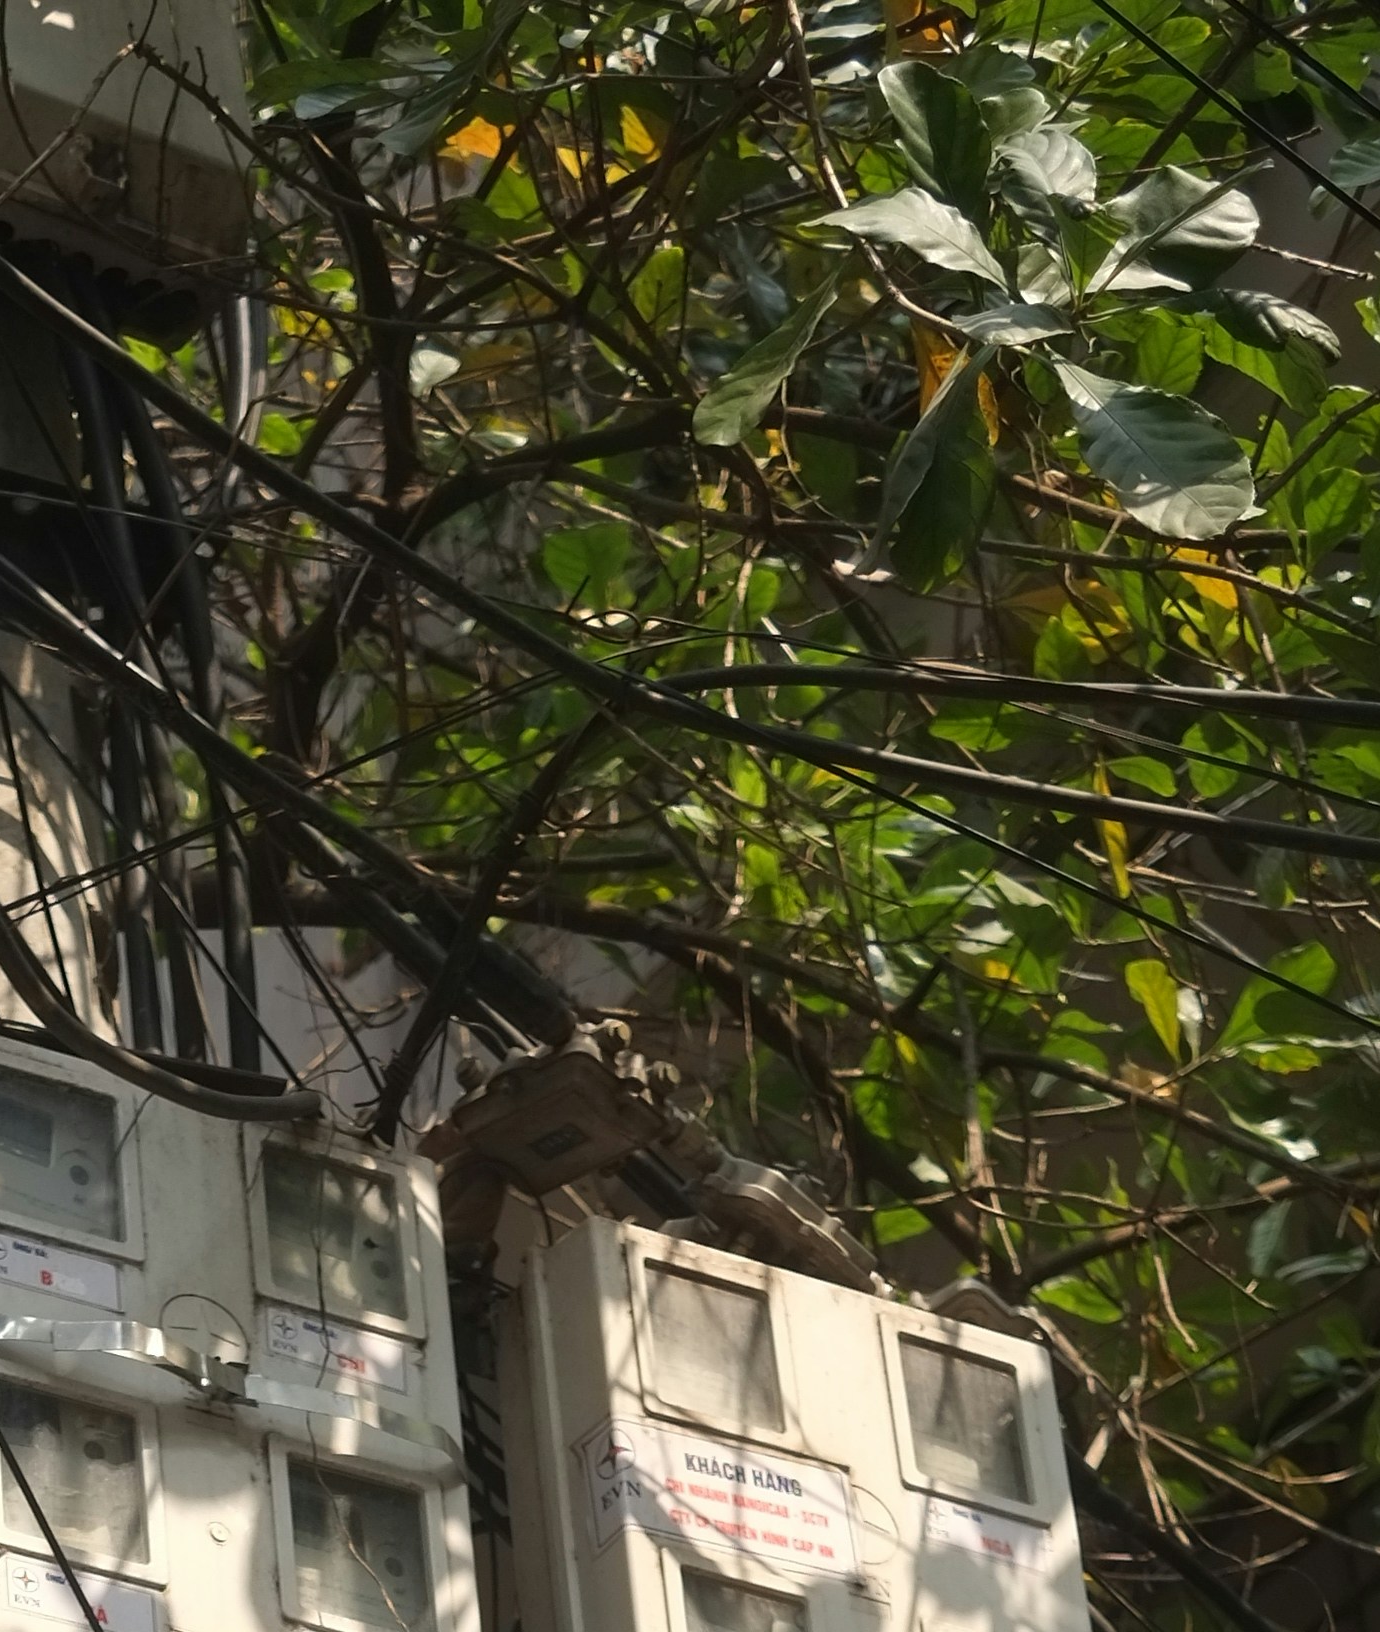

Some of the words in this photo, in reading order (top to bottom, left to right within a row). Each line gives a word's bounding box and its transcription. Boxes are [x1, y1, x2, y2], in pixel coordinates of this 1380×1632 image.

[685, 1453, 747, 1484] KHÁCH
[752, 1469, 803, 1497] HÀNG
[603, 1482, 641, 1511] EVN
